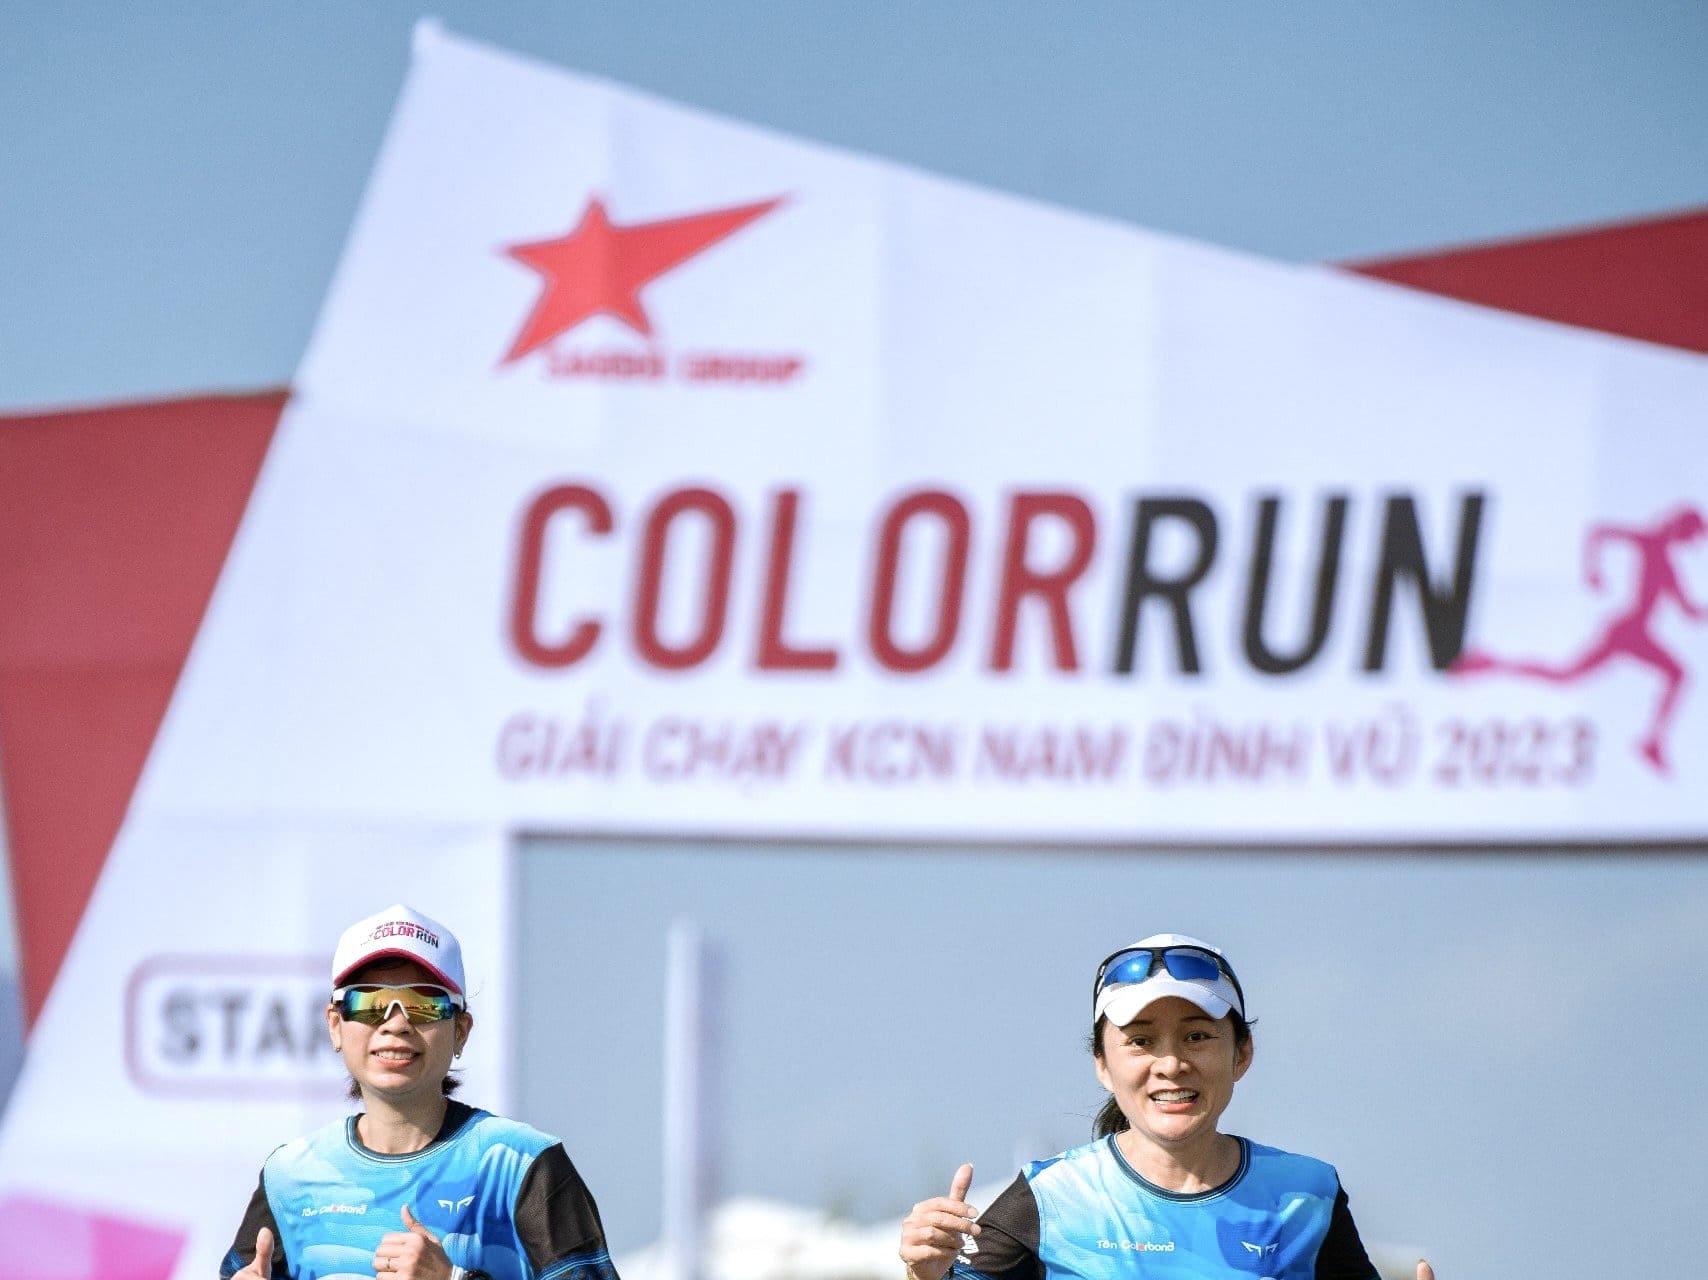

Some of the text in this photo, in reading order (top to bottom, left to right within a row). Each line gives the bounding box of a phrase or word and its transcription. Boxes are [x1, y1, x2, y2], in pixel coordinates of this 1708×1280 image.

[826, 714, 959, 786] KCN
[978, 716, 1128, 785] NAM
[1434, 717, 1597, 787] 2023
